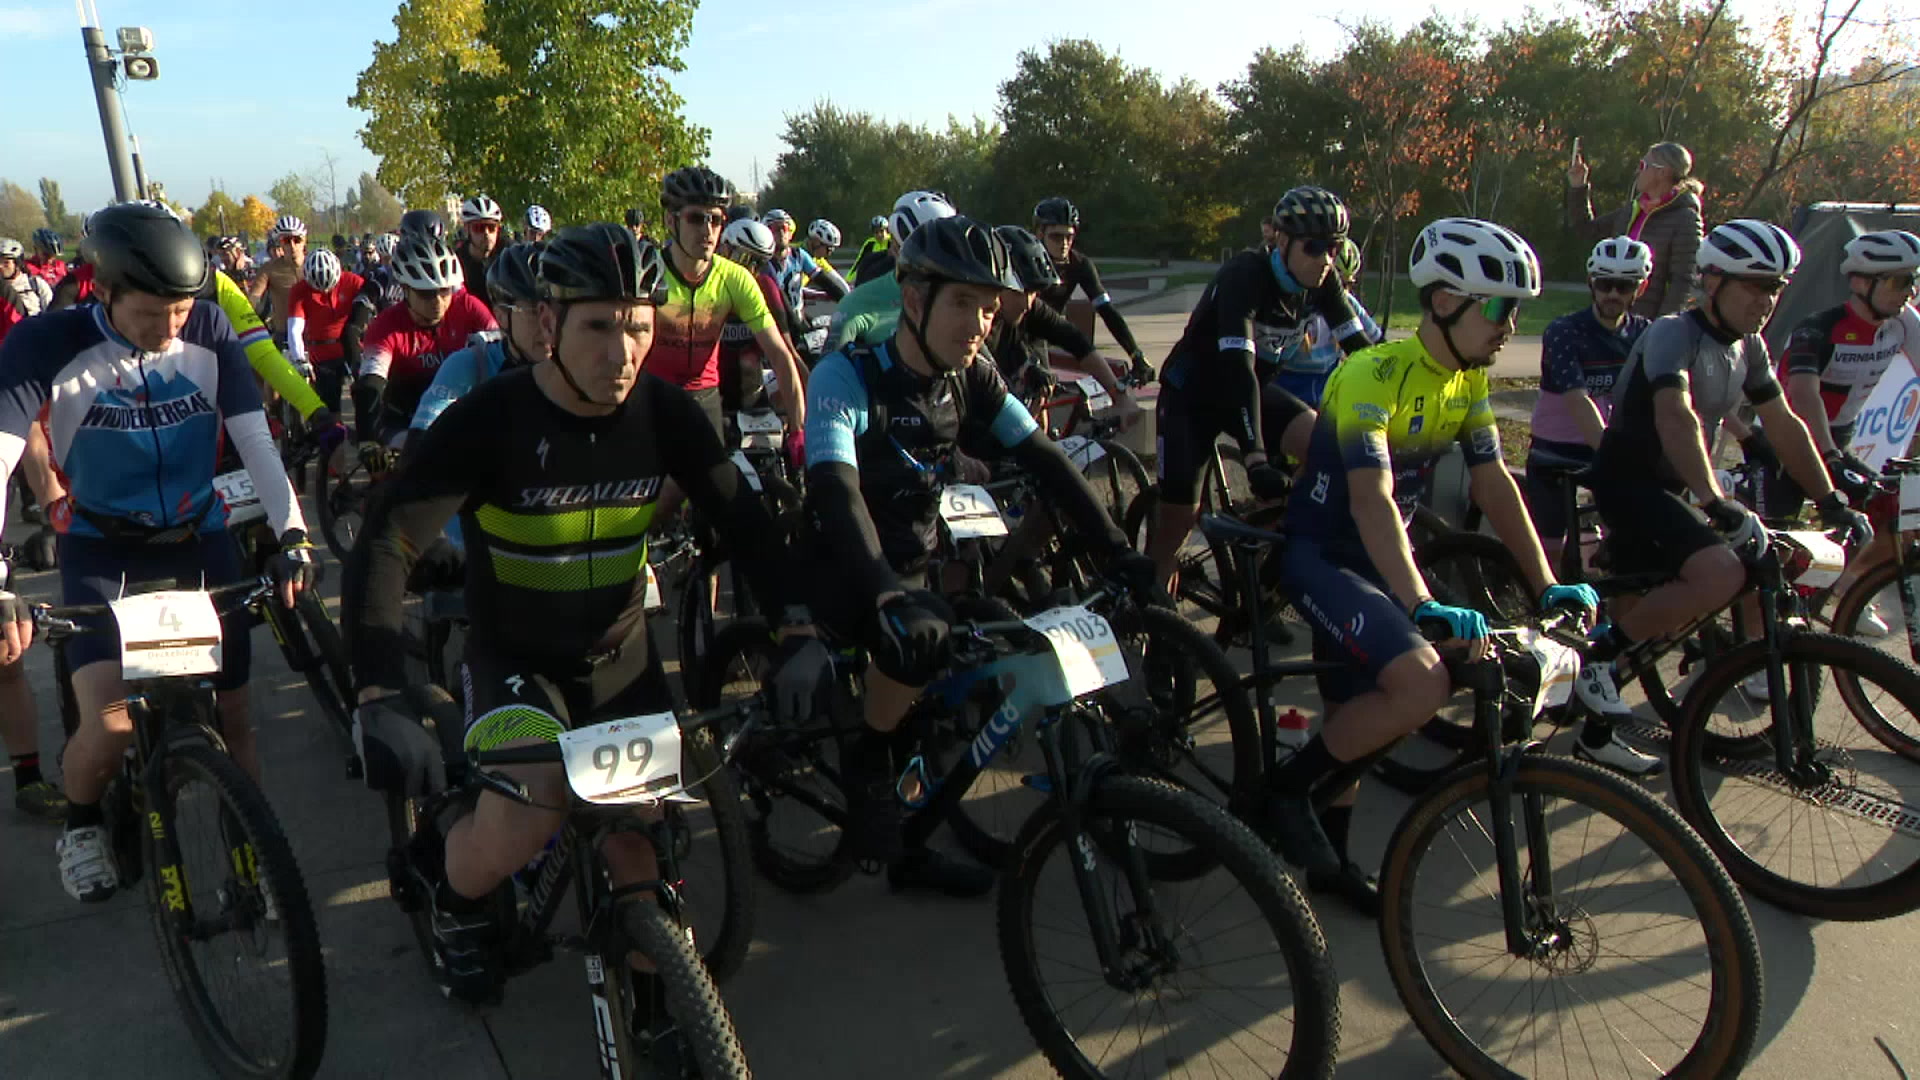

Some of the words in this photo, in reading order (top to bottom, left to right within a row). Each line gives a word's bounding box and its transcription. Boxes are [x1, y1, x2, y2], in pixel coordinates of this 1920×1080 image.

[949, 492, 977, 513] 67
[158, 606, 183, 632] 4
[1045, 615, 1108, 646] 9003
[592, 736, 653, 785] 99
